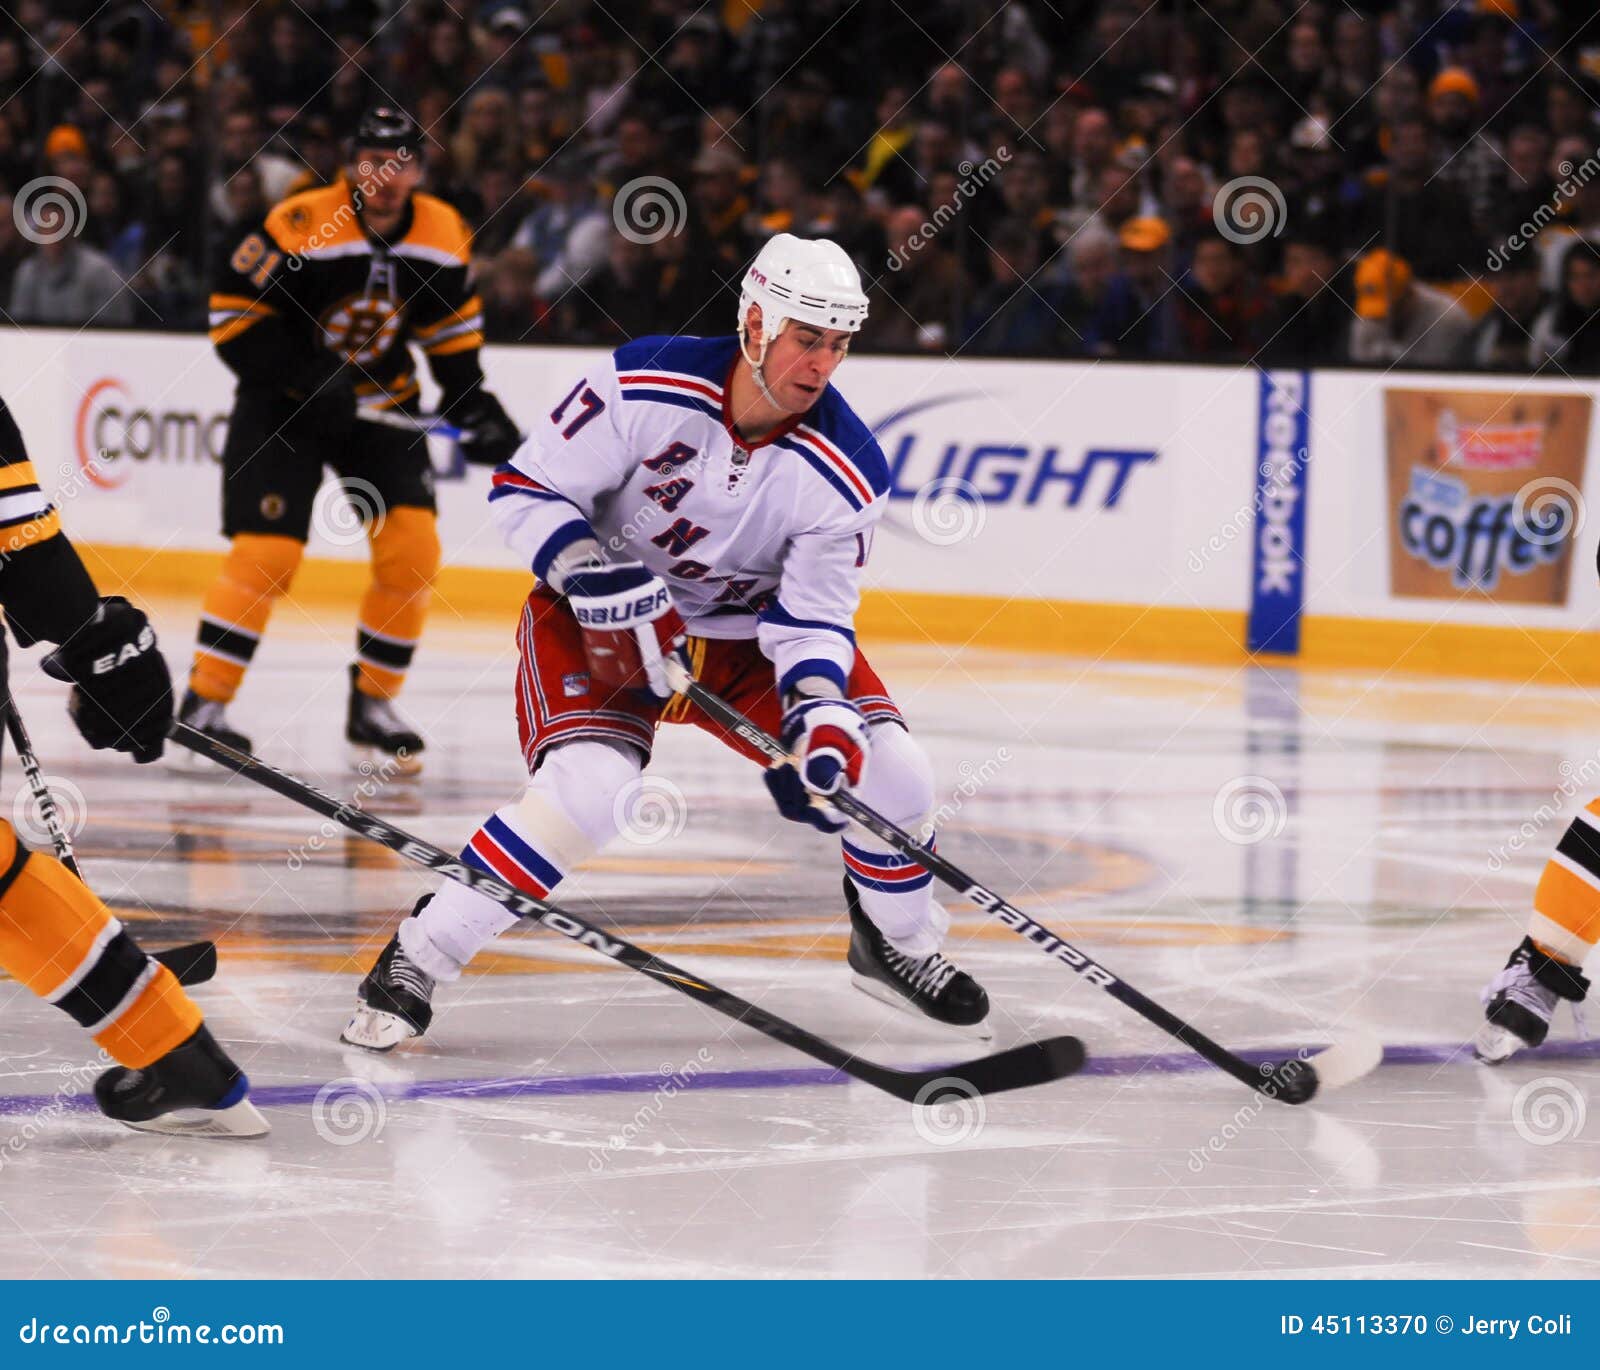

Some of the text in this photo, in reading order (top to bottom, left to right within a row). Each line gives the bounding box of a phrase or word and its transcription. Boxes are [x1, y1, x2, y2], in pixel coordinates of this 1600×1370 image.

[231, 234, 281, 289] 81
[550, 377, 606, 441] 17
[889, 433, 1159, 508] LIGHT
[576, 587, 669, 624] BAUER
[398, 841, 625, 957] EASTON
[964, 884, 1117, 989] BAUER
